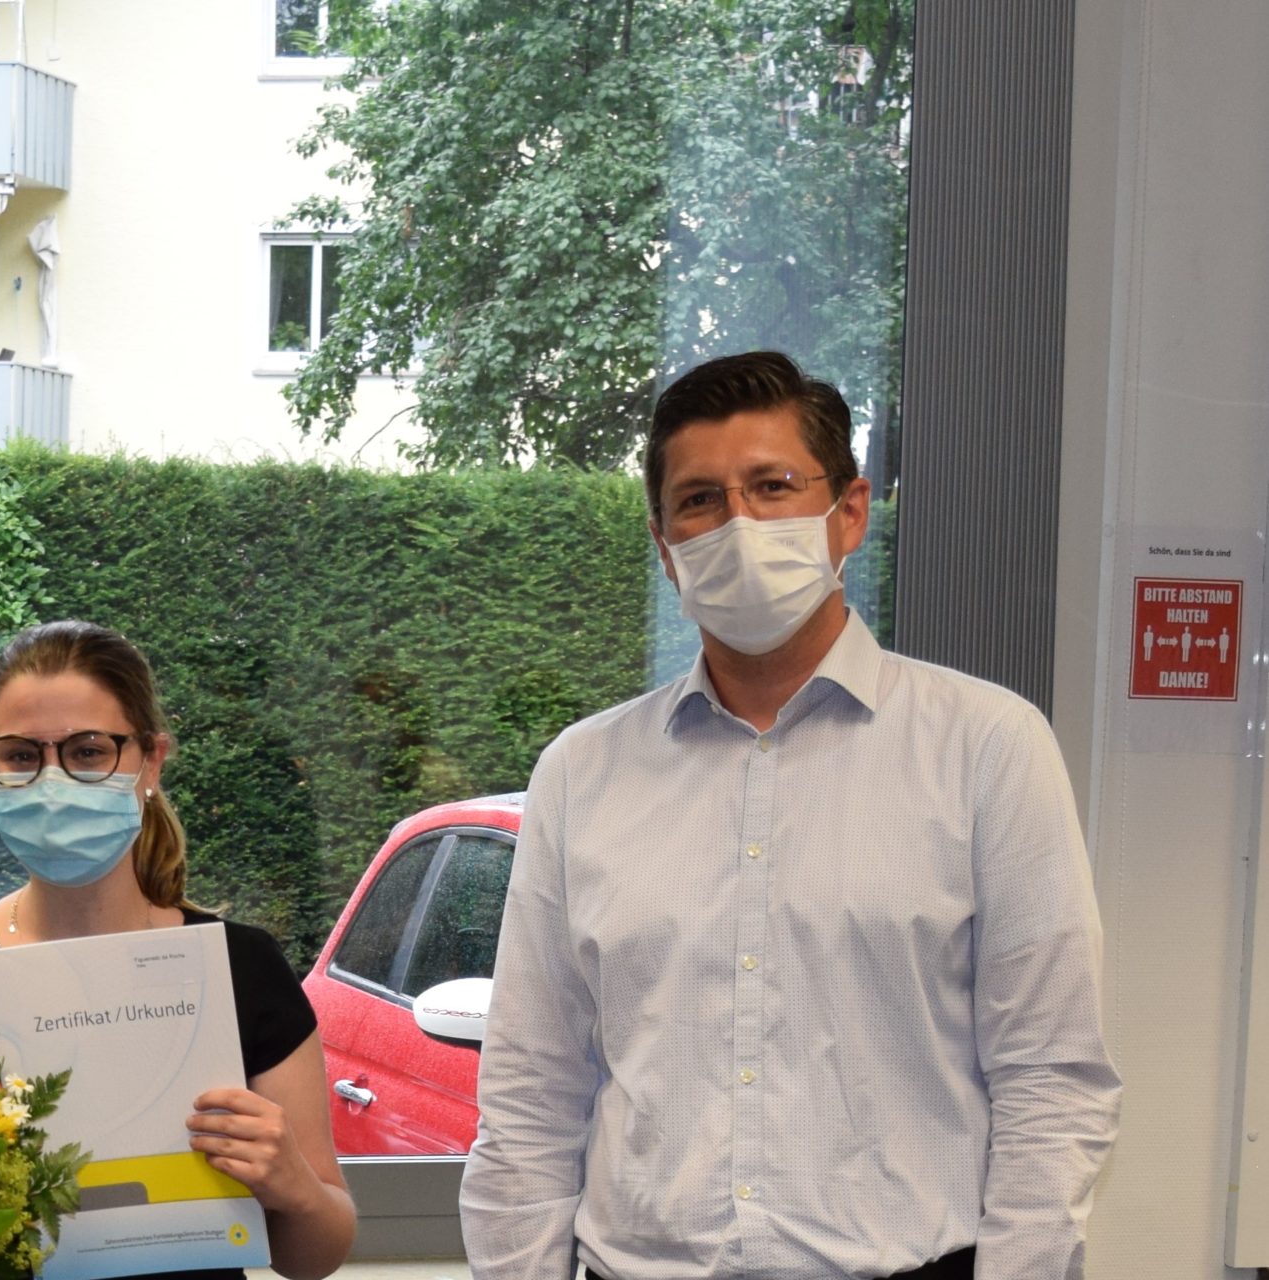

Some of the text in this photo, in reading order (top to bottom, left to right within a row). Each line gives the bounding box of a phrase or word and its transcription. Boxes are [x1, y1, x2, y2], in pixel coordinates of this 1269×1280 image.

[1148, 546, 1173, 556] Schön,
[1193, 548, 1204, 557] Sie
[1205, 548, 1214, 557] da
[1216, 549, 1232, 558] sind
[1144, 587, 1233, 605] BITTE ABSTAND
[1166, 608, 1209, 624] HALTEN
[1159, 671, 1209, 689] DANKE!
[33, 1000, 196, 1033] Zertifikat / Urkunde
